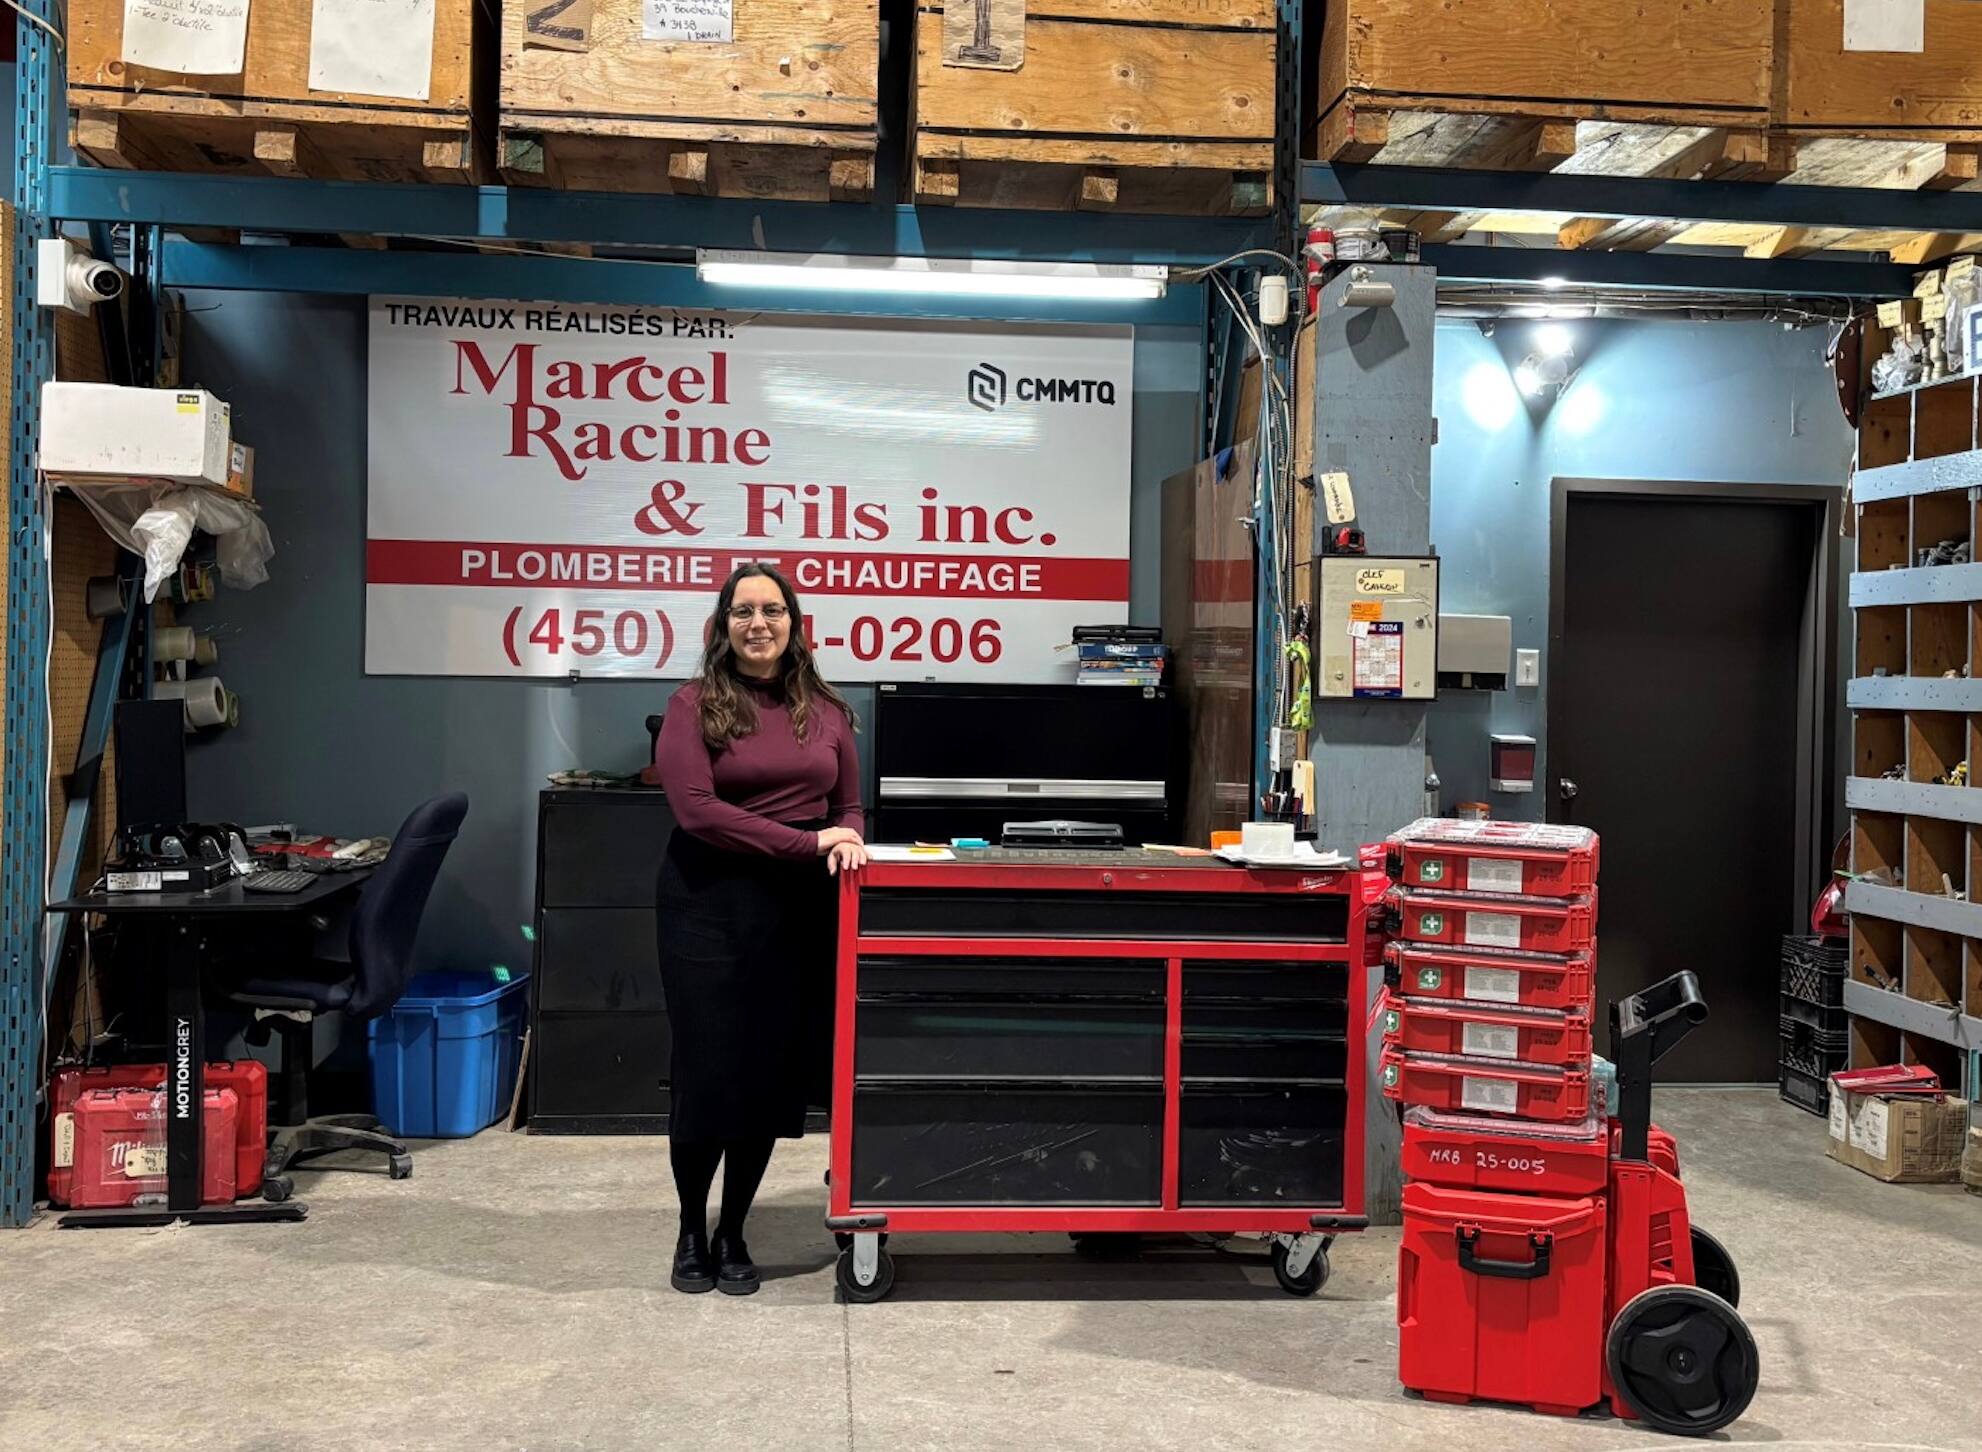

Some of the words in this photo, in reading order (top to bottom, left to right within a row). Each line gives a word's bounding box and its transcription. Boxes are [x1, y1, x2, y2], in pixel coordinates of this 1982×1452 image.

[385, 303, 515, 330] TRAVAUX
[524, 305, 664, 336] RÉALISÉS
[448, 339, 731, 405] Marcel
[1016, 377, 1117, 407] CMMTQ
[502, 403, 772, 481] Racine
[633, 479, 706, 536] &
[736, 482, 890, 542] Fils
[915, 486, 1058, 547] inc.
[461, 549, 713, 584] PLOMBERIE
[796, 558, 1042, 592] CHAUFFAGE
[501, 605, 675, 669] (450)
[1378, 624, 1398, 632] 2024
[176, 1018, 190, 1119] MOTIONGREY
[1476, 1151, 1546, 1175] 25-005
